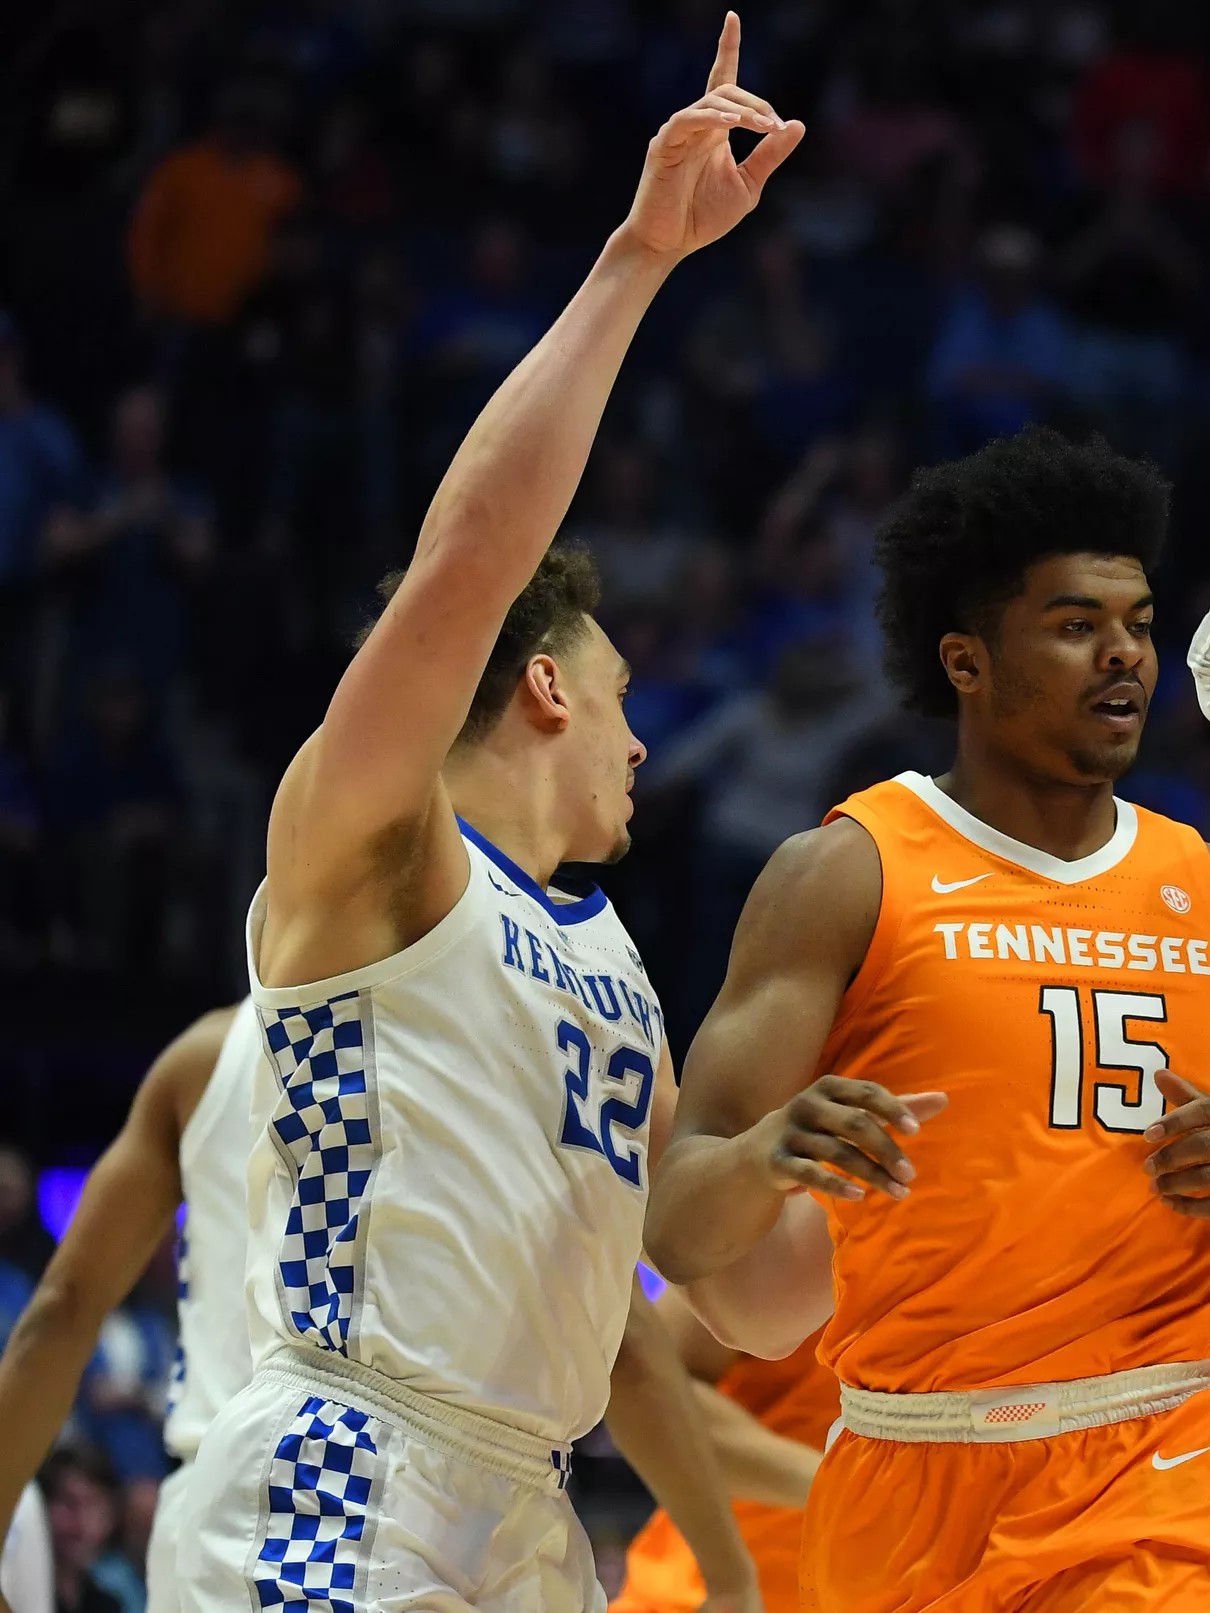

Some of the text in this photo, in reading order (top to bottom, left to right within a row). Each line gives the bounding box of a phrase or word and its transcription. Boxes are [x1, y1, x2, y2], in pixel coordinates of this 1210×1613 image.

[1162, 887, 1190, 911] SEC
[556, 1019, 656, 1190] 22
[1038, 985, 1170, 1134] 15
